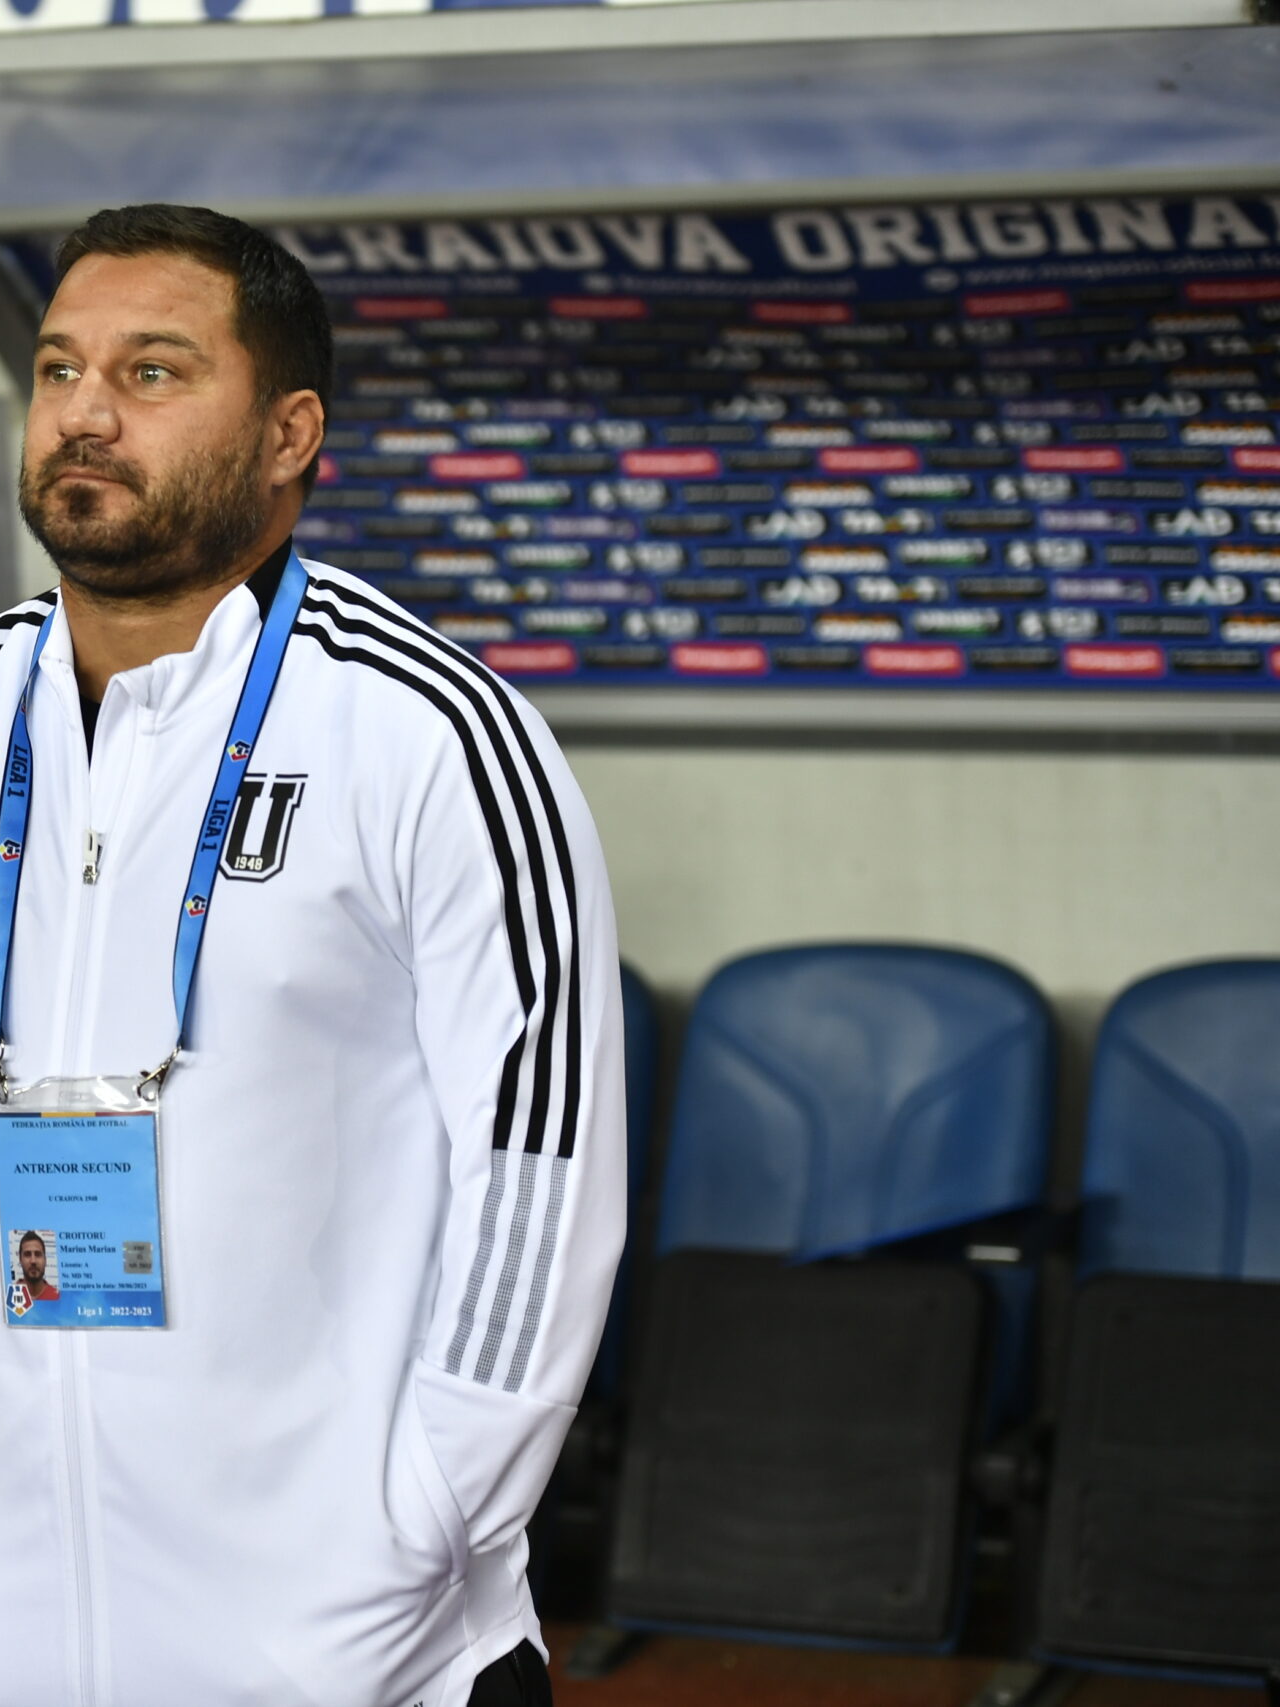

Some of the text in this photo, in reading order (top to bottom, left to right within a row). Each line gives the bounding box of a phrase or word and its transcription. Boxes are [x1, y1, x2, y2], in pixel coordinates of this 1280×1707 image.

[772, 196, 1280, 272] ORIGINA
[7, 744, 28, 797] LIGA 1
[201, 799, 230, 852] LIGA 1
[234, 856, 263, 871] 1948
[14, 1162, 132, 1174] ANTRENOR SECUND
[59, 1231, 106, 1240] CROITORU
[60, 1245, 116, 1253] Marius Marian
[77, 1307, 96, 1317] Liga
[110, 1307, 152, 1316] 2022-2023
